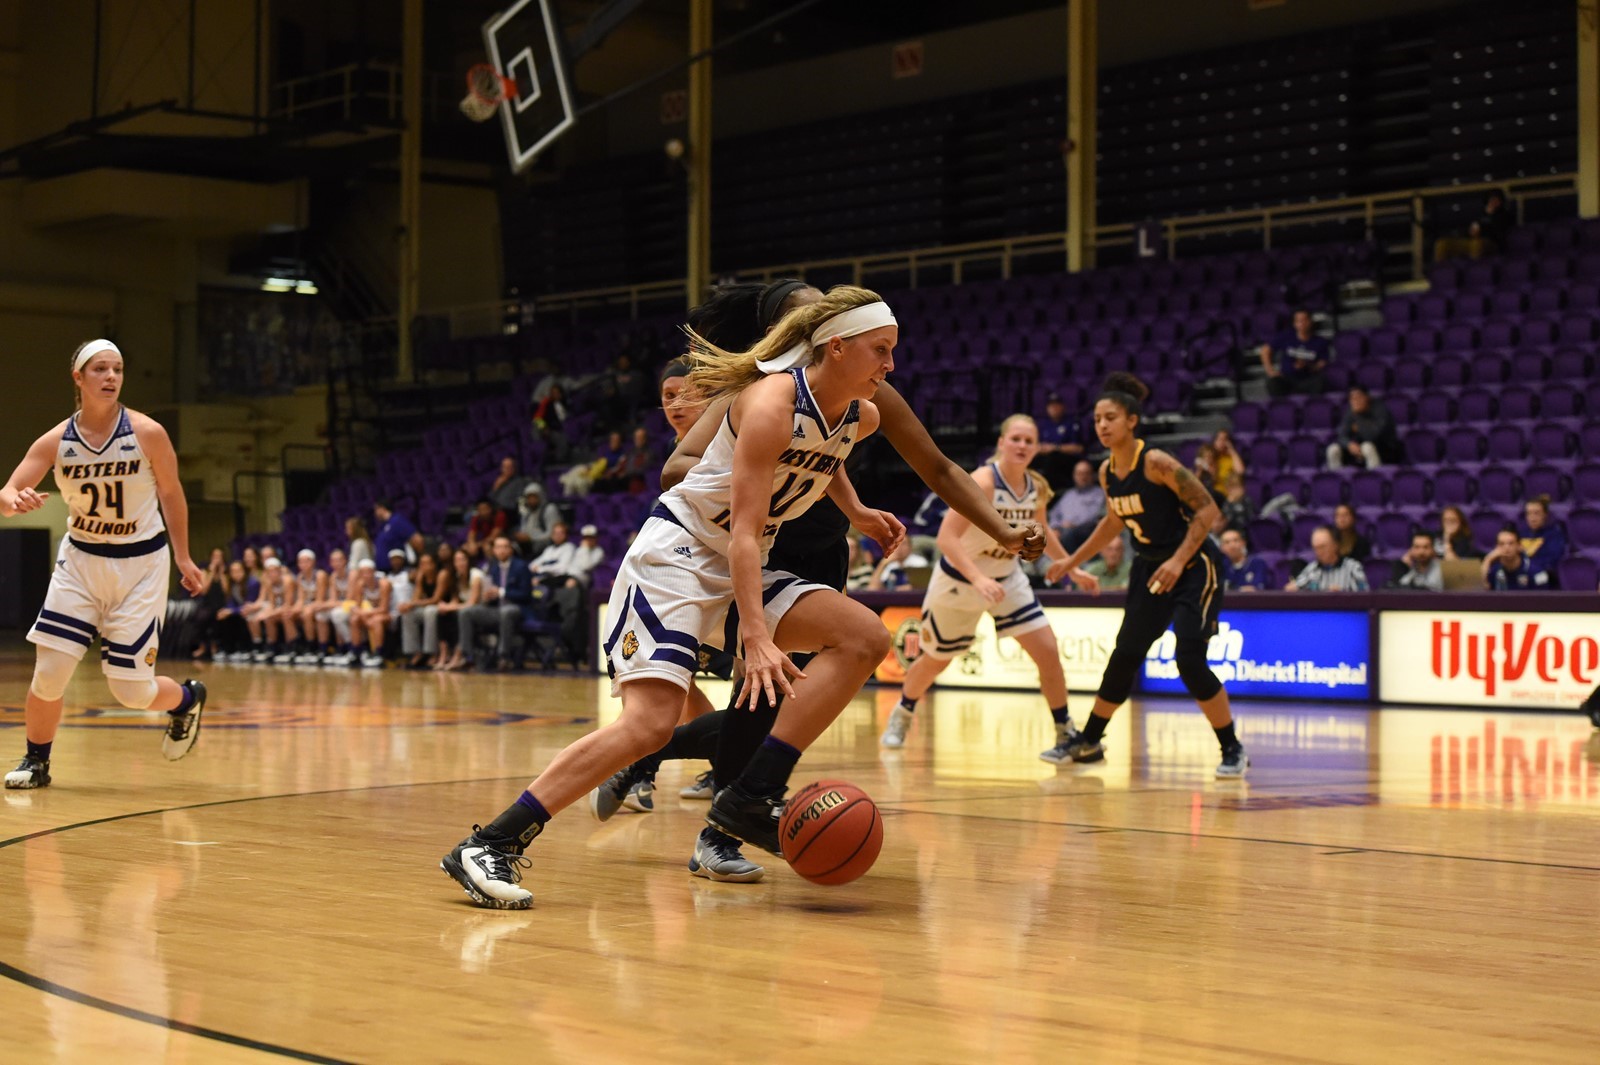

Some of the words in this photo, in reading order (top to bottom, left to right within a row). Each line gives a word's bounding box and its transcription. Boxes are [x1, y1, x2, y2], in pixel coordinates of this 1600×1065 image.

[1139, 228, 1156, 257] L
[62, 459, 141, 479] WESTERN
[80, 481, 124, 519] 24
[71, 516, 139, 536] ILLINOIS
[1431, 620, 1599, 696] HyVee
[1236, 659, 1296, 682] District
[1297, 660, 1367, 688] Hospital
[787, 790, 848, 841] Wilson
